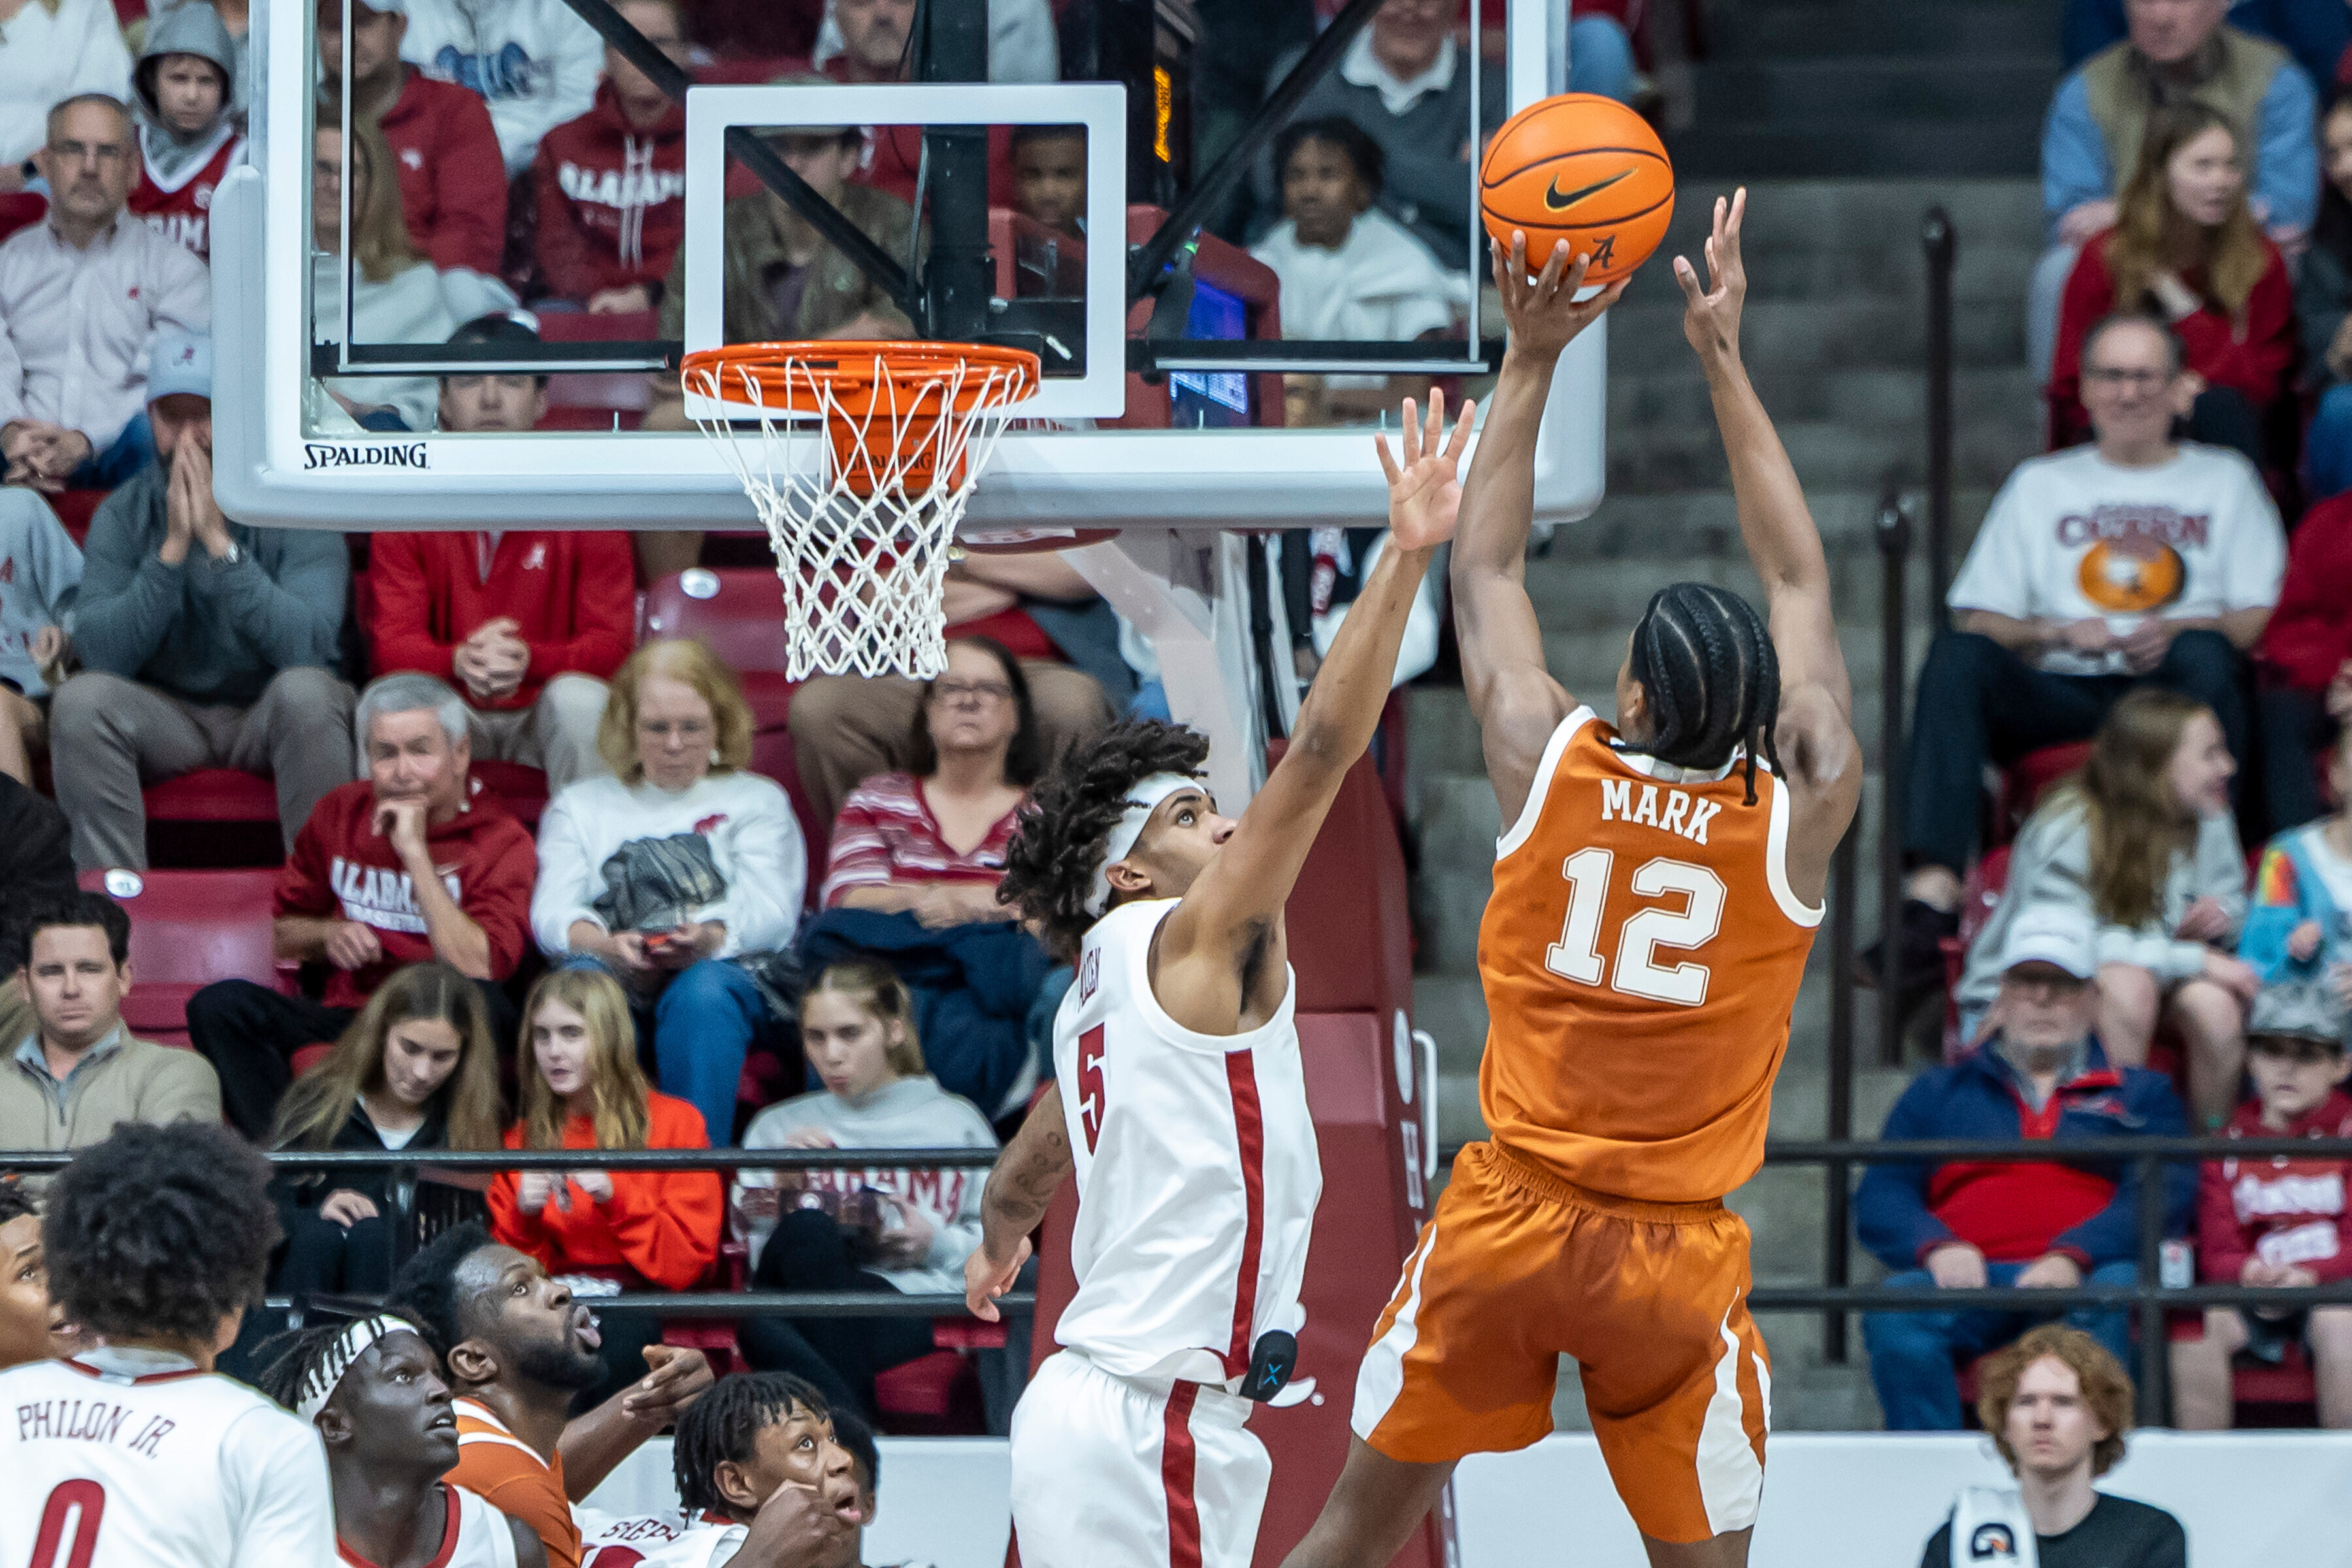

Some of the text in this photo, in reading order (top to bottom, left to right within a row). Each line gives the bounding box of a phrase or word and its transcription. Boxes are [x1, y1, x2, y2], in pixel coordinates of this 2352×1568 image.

[304, 442, 427, 470] SPALDING
[847, 451, 933, 472] SPALING
[1601, 779, 1722, 846] MARK
[1544, 847, 1728, 1007] 12
[1078, 1022, 1105, 1158] 5
[18, 1399, 134, 1443] PHILON
[28, 1478, 106, 1568] 0
